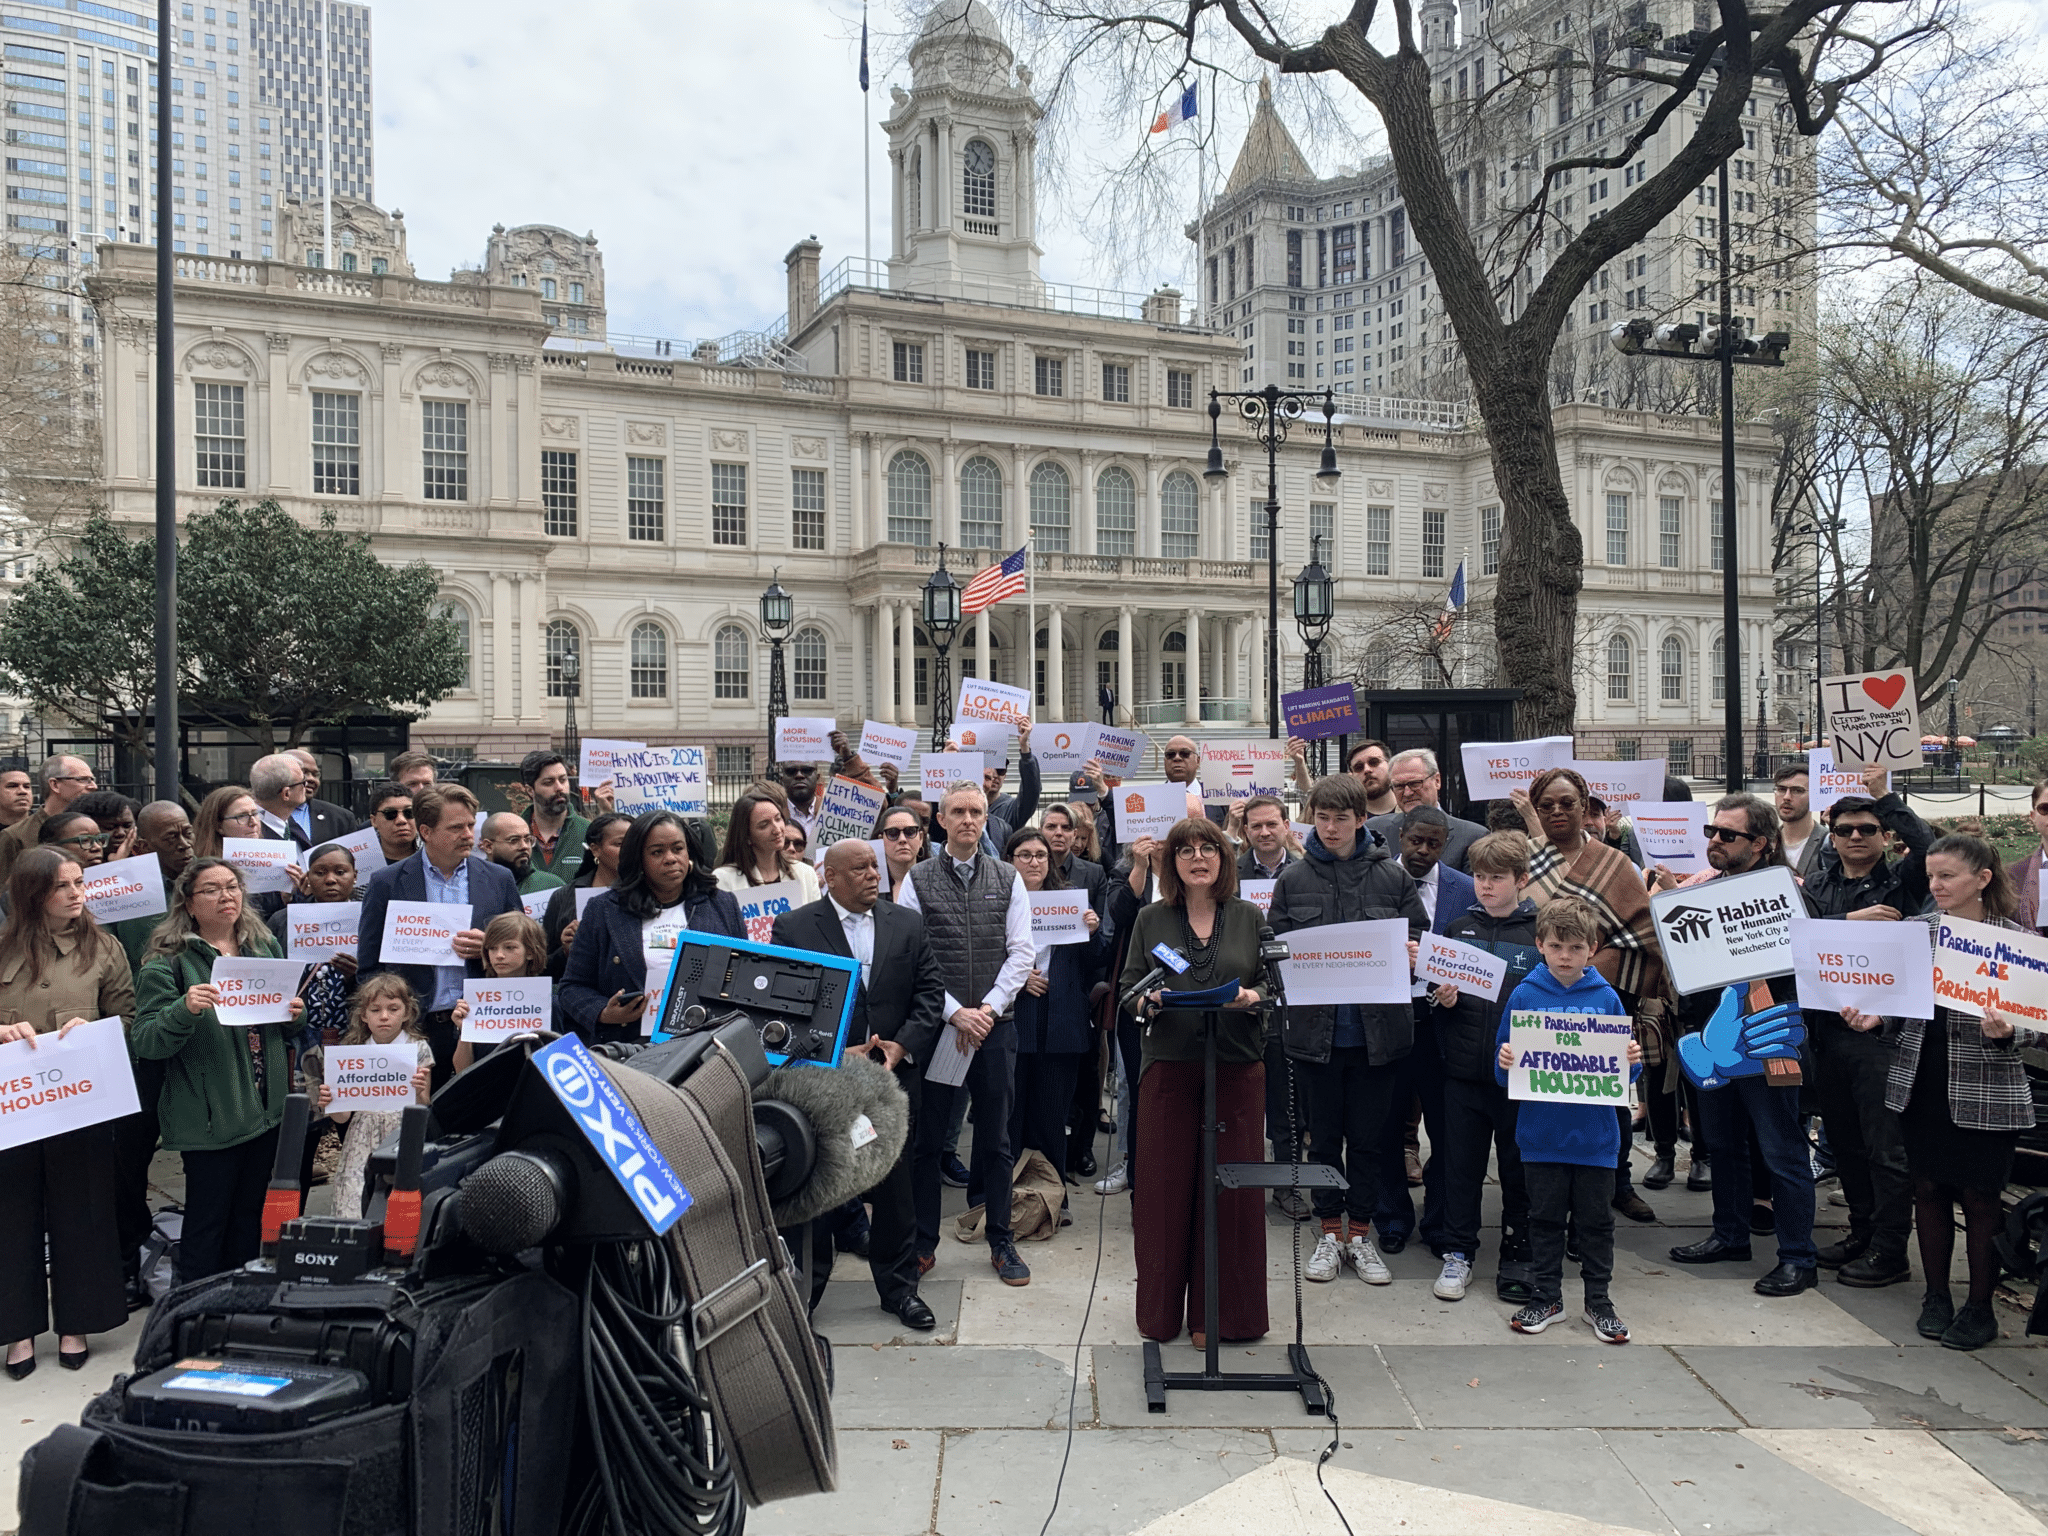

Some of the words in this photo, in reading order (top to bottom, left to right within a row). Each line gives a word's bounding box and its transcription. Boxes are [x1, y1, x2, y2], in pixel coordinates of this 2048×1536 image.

[1826, 681, 1864, 714] I
[964, 693, 1022, 716] LOCAL
[1290, 704, 1354, 726] CLIMATE
[783, 727, 807, 735] MORE
[1842, 720, 1887, 732] MANDATES
[783, 736, 822, 744] HOUSING
[863, 741, 878, 750] ENDS
[865, 733, 907, 749] HOUSING
[1099, 732, 1136, 747] PARKING
[1835, 727, 1914, 764] NYC
[589, 750, 610, 758] MOR
[671, 748, 703, 766] 2024
[1095, 749, 1131, 763] PARKING
[1487, 758, 1510, 768] YES
[1512, 757, 1530, 768] TO
[1820, 763, 1837, 773] PLA
[682, 771, 701, 783] WE
[925, 769, 945, 778] YES
[947, 768, 962, 778] TO
[1820, 774, 1864, 786] PEOPL
[643, 784, 677, 798] LIFT
[827, 778, 850, 799] LIFT
[1588, 782, 1608, 791] YES
[1611, 782, 1626, 792] TO
[1599, 792, 1641, 802] OUSING
[1145, 814, 1176, 824] destiny
[816, 813, 824, 828] A
[825, 815, 870, 841] CLIMATE
[1127, 825, 1159, 834] housing
[1654, 828, 1687, 836] HOUSING
[231, 851, 287, 860] AFFORDABLE
[231, 860, 272, 868] HOUSING
[85, 882, 144, 902] HOUSING
[1250, 891, 1273, 900] MOR
[1031, 905, 1079, 916] OUSING
[1716, 894, 1790, 924] Habitat
[397, 915, 431, 925] MORE
[294, 923, 320, 934] YES
[324, 922, 341, 932] TO
[395, 926, 450, 938] HOUSING
[1722, 924, 1738, 934] for
[294, 935, 359, 948] HOUSING
[401, 938, 425, 946] EVERY
[1726, 936, 1744, 945] New
[1745, 930, 1764, 941] York
[1765, 927, 1781, 936] City
[1432, 943, 1457, 959] YES
[1461, 951, 1479, 963] TO
[1729, 940, 1777, 957] Westchester
[1292, 952, 1322, 960] MORE
[1325, 951, 1373, 960] HOUSING
[1817, 952, 1844, 966] YES
[1847, 954, 1869, 968] TO
[1302, 962, 1324, 970] EVERY
[1326, 960, 1387, 969] NEIGHBORHOOD
[1428, 955, 1494, 979] Affordable
[1975, 960, 2009, 981] ARE
[1426, 963, 1493, 990] HOUSING
[1819, 970, 1895, 986] HOUSING
[217, 979, 243, 991] YES
[247, 978, 266, 990] TO
[217, 992, 283, 1007] HOUSING
[476, 991, 502, 1002] YES
[506, 990, 525, 1001] TO
[475, 1005, 542, 1016] Affordable
[669, 985, 685, 1026] DRACAST
[474, 1018, 543, 1030] HOUSING
[1555, 1032, 1582, 1047] FOR
[337, 1058, 365, 1070] YES
[369, 1057, 388, 1069] TO
[572, 1043, 600, 1079] OWN
[1519, 1050, 1620, 1073] AFFORDABLE
[0, 1076, 33, 1096] YES
[35, 1068, 63, 1085] TO
[337, 1072, 407, 1084] Affordable
[1529, 1069, 1623, 1097] HOUSING
[0, 1079, 93, 1115] HOUSING
[337, 1085, 408, 1098] HOUSING
[598, 1079, 625, 1117] VERY
[626, 1115, 662, 1169] YORK'S
[663, 1168, 687, 1201] NEW
[294, 1252, 339, 1266] SONY
